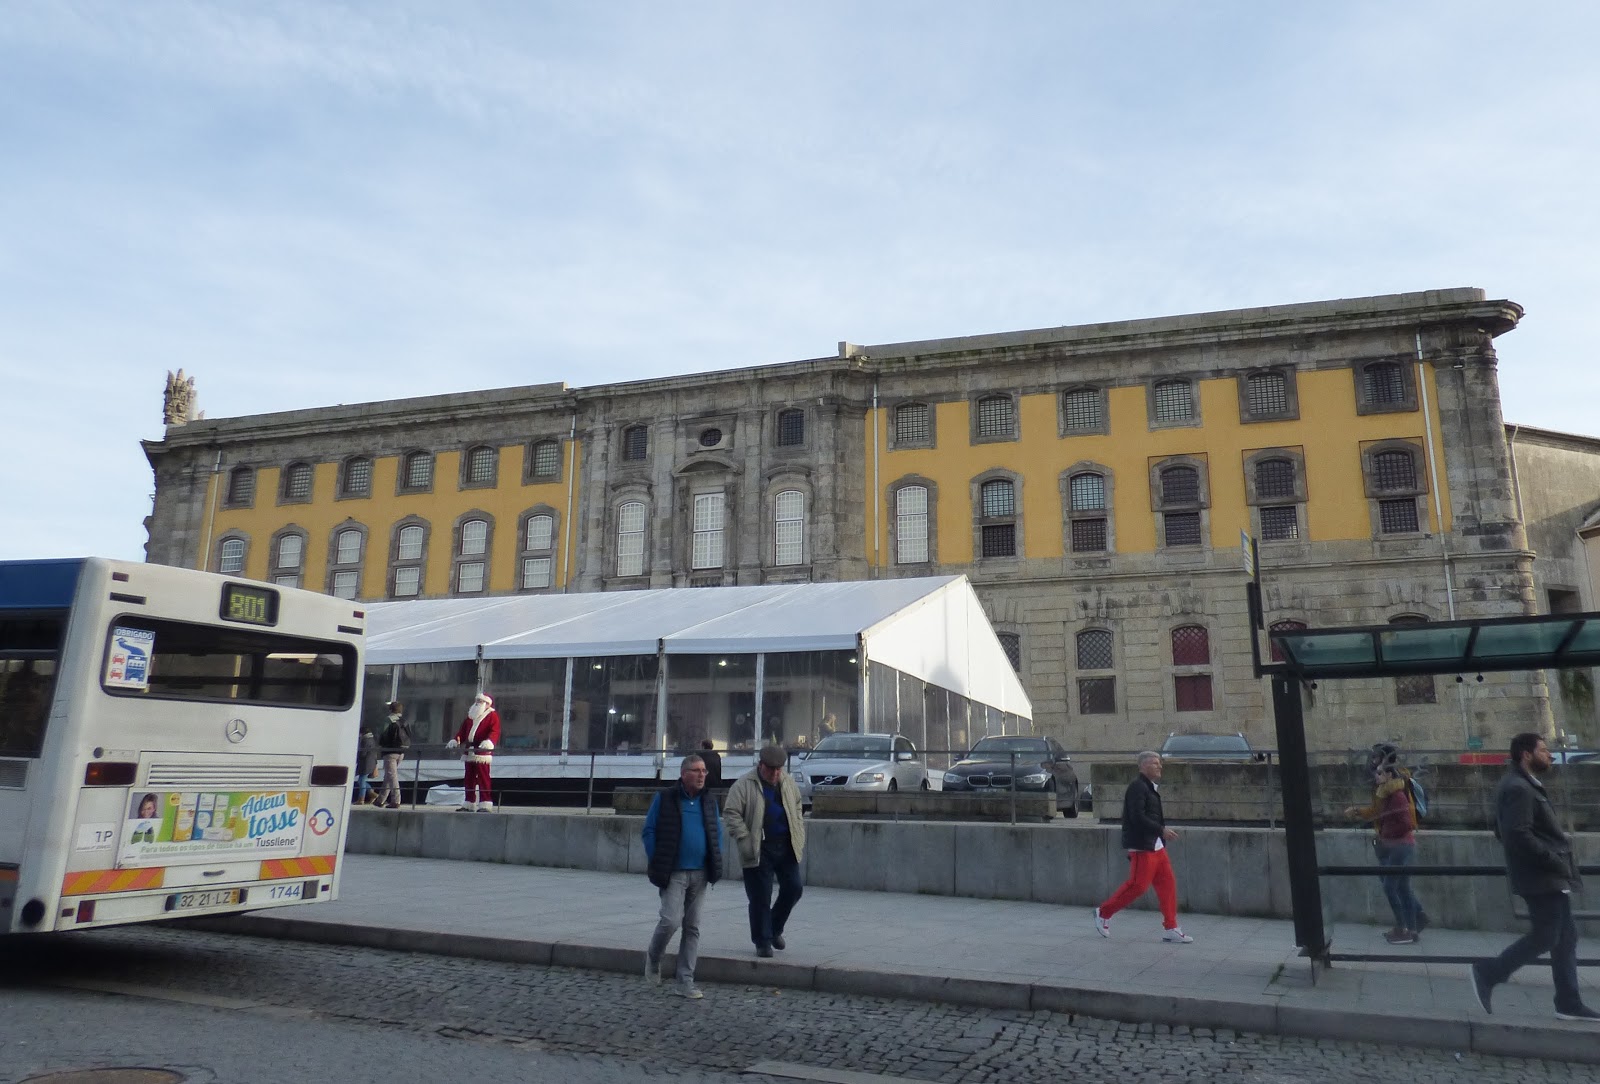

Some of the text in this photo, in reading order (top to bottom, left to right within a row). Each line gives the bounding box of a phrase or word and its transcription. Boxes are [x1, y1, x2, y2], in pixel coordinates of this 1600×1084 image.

[116, 628, 153, 640] OBRIGADO
[242, 793, 286, 818] Adeus
[248, 808, 299, 839] tosse
[270, 885, 300, 899] 1744
